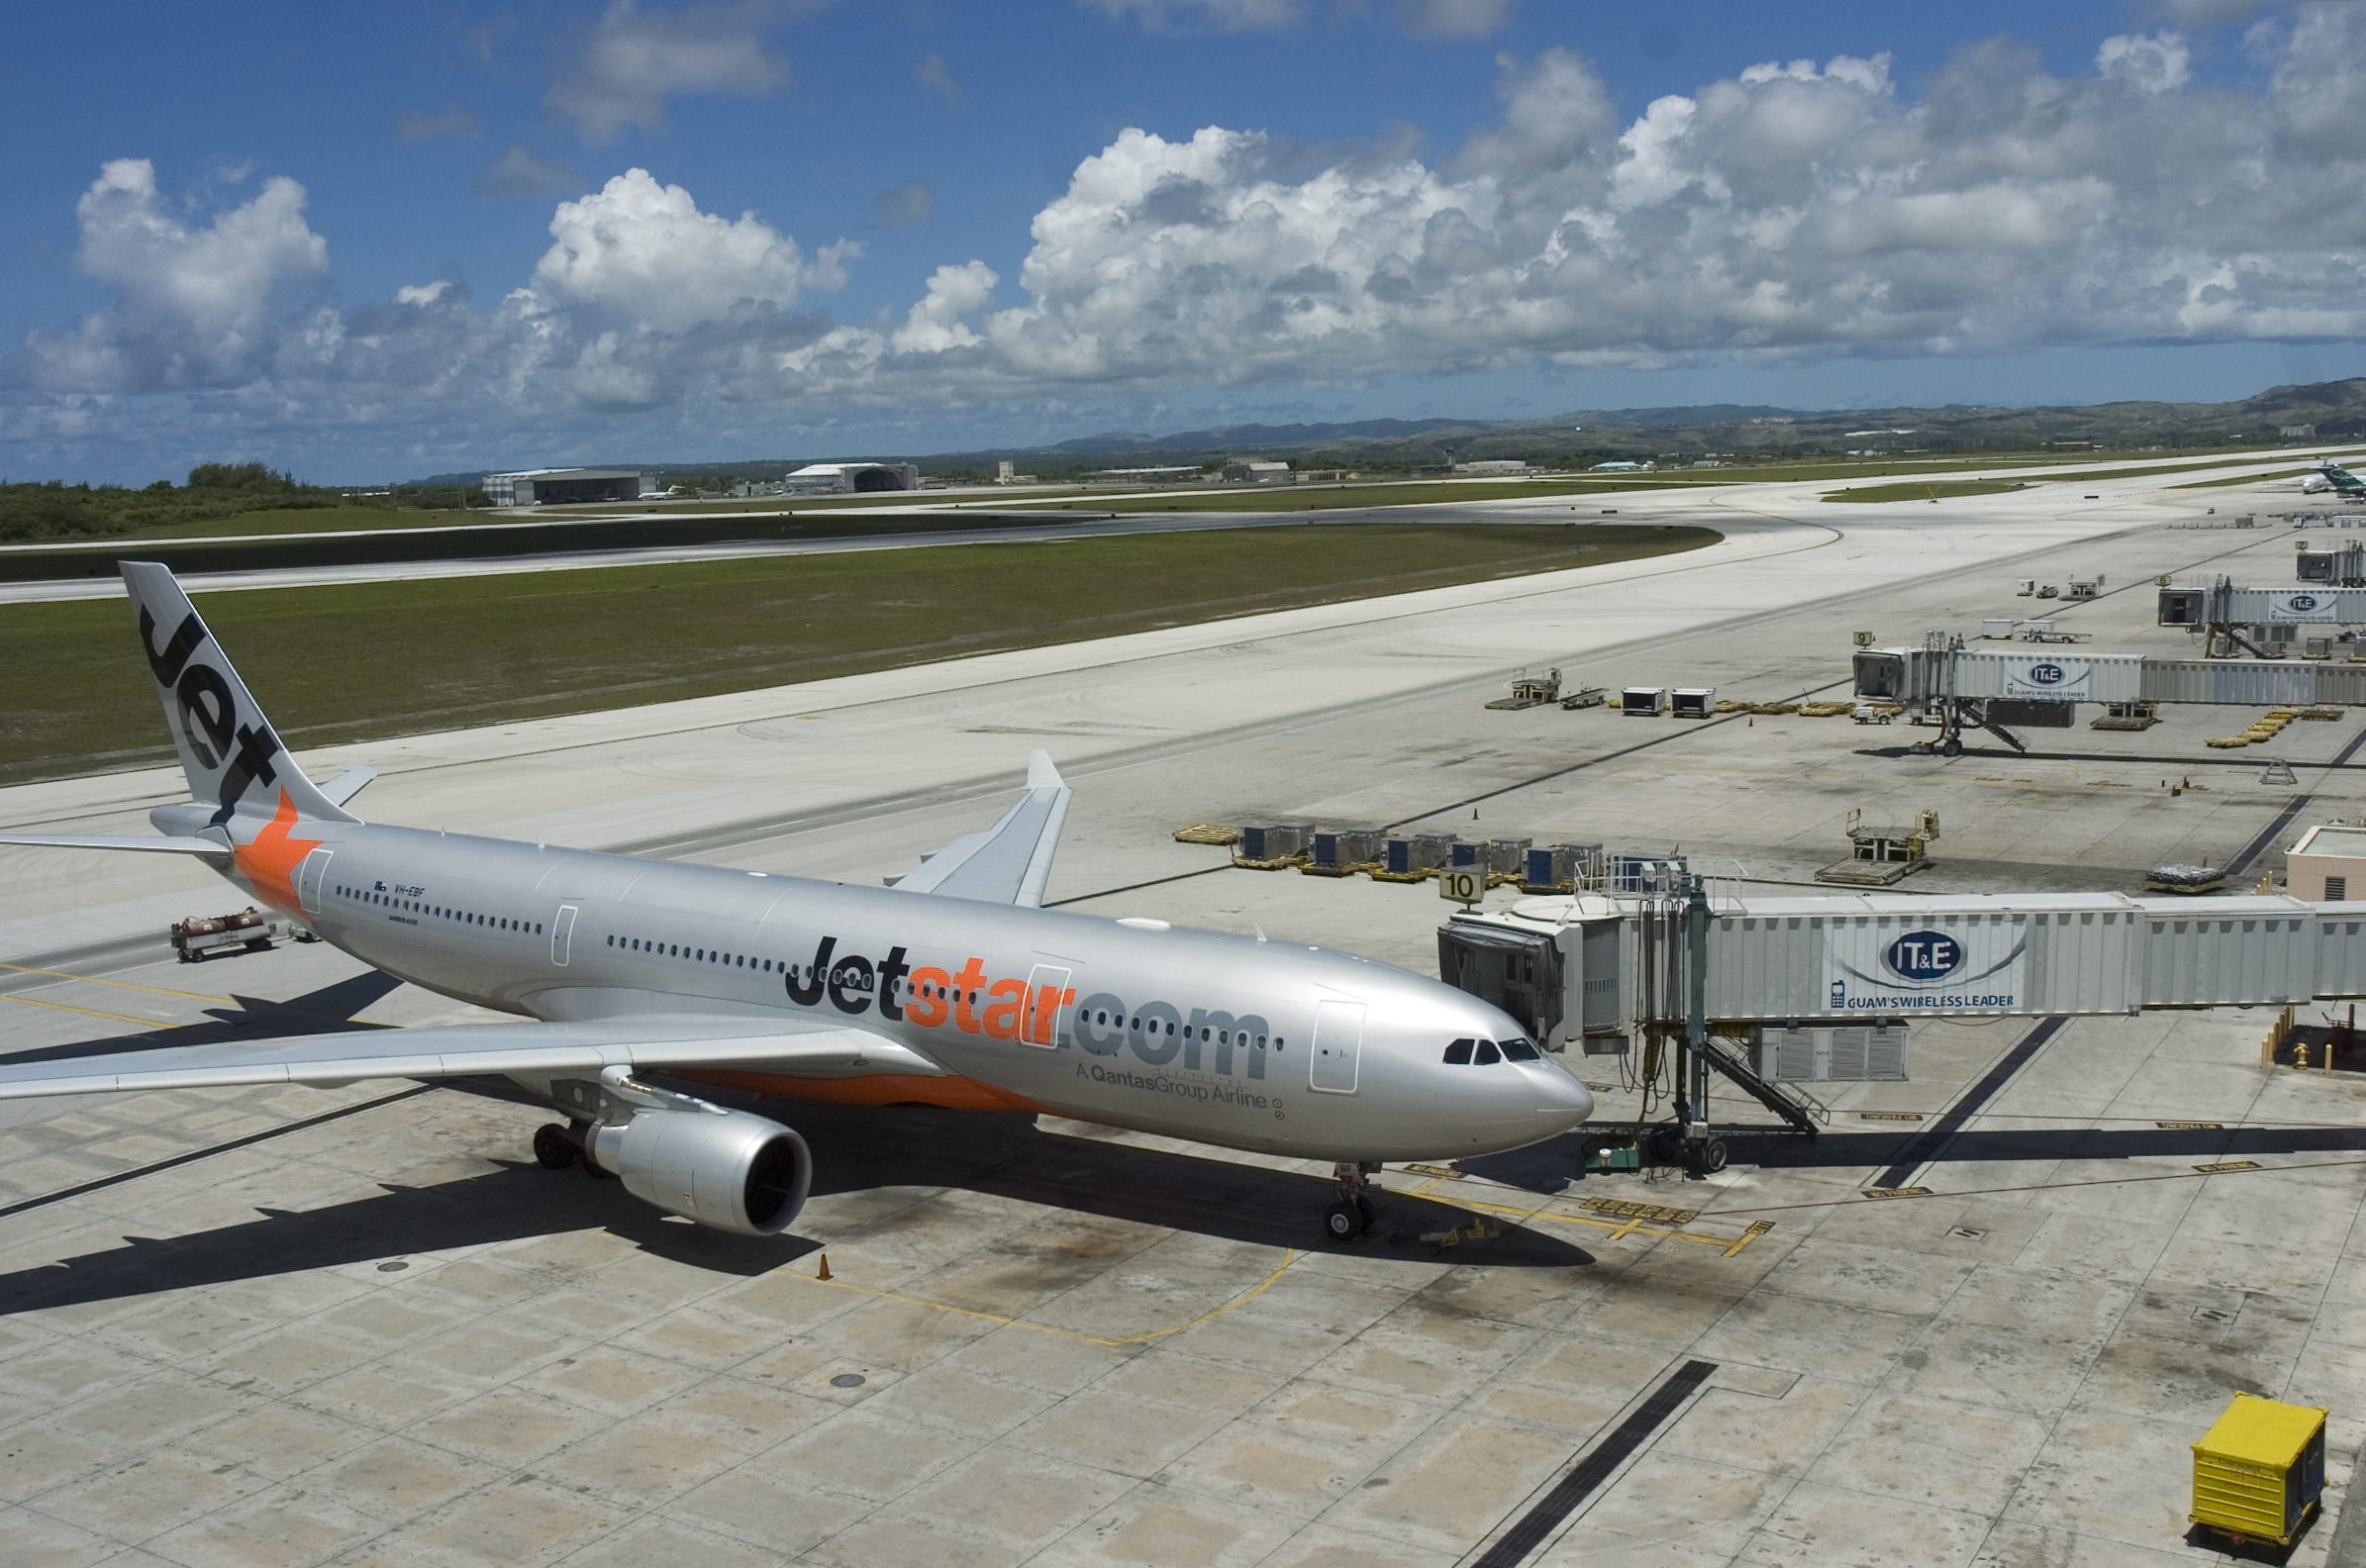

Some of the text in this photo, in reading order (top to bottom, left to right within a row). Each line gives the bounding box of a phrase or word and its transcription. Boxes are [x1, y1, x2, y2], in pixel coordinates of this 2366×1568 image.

[1858, 633, 1866, 643] 9
[2034, 667, 2059, 681] IT&E
[395, 884, 426, 898] VH-EBF
[1446, 874, 1474, 898] 10
[1897, 941, 1951, 970] IT&E
[1847, 995, 2015, 1009] GUAM'S WIRELESS LEADER
[1076, 1062, 1089, 1078] A
[1213, 1086, 1267, 1109] Airline
